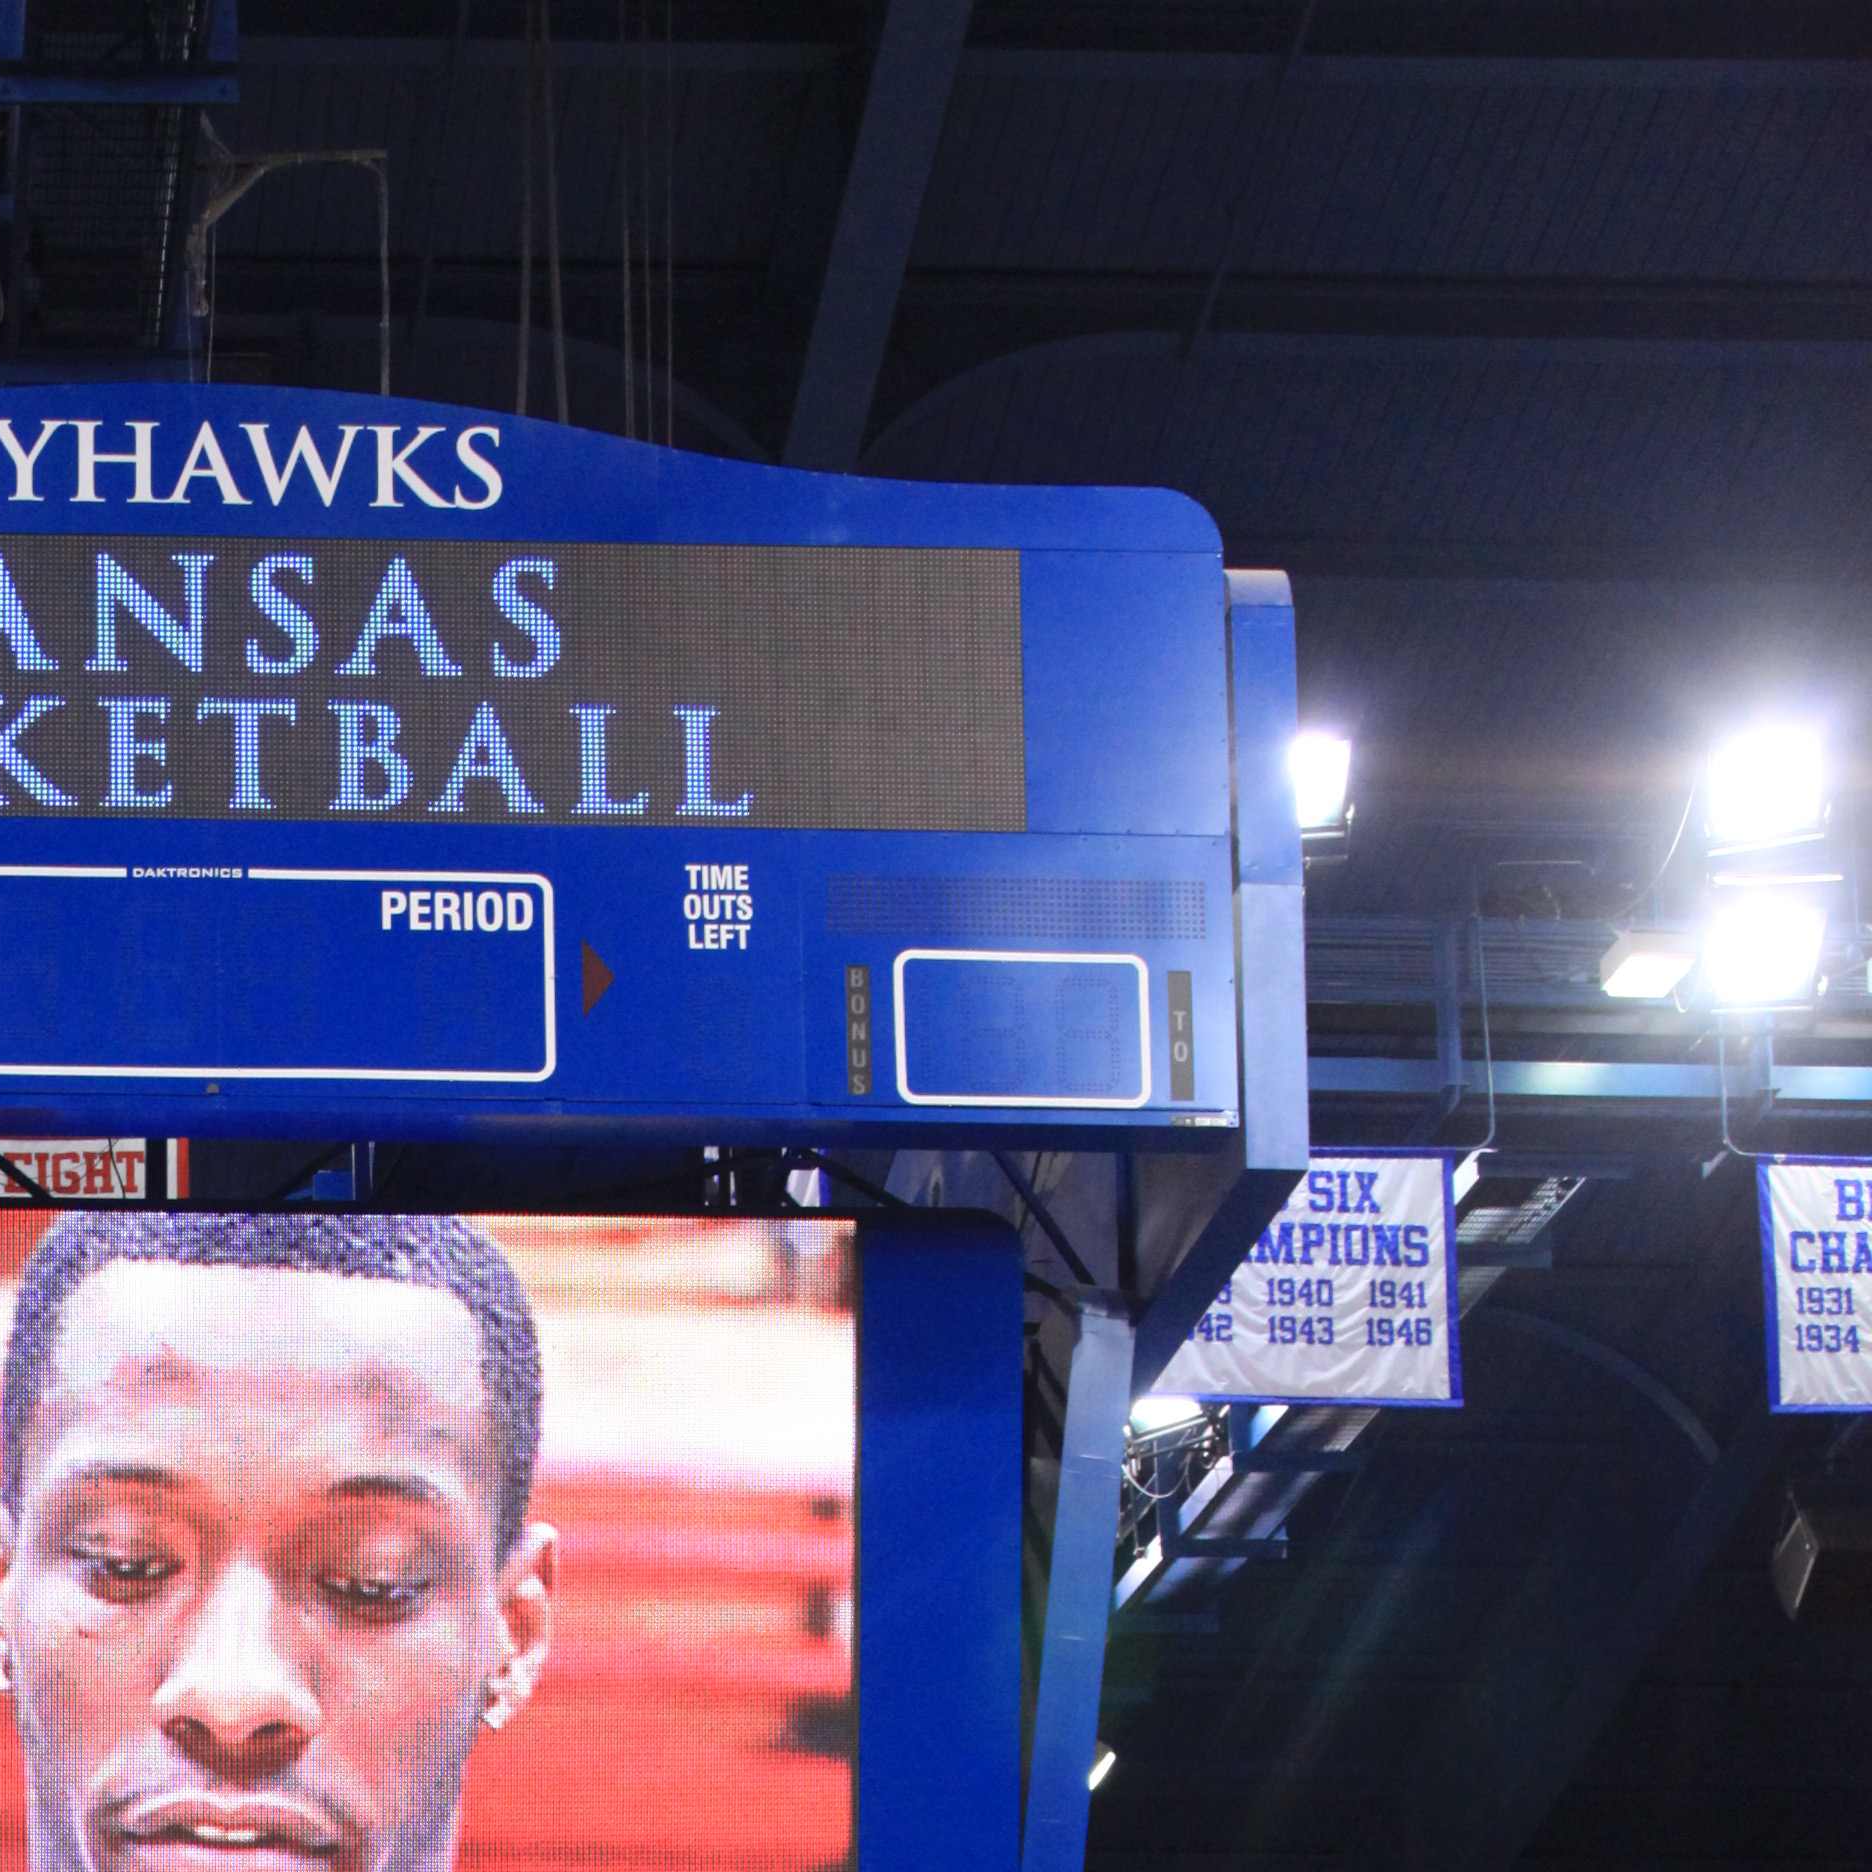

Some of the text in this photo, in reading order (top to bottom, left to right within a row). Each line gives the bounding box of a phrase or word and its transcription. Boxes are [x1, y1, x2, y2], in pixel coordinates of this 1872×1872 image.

[131, 868, 243, 879] DAKTRONICS
[684, 864, 749, 891] TIME
[381, 891, 534, 933] PERIOD
[683, 893, 753, 922] OUTS
[687, 924, 750, 951] LEFT
[849, 967, 868, 1096] BONUS
[1171, 1010, 1188, 1063] TO
[2, 1151, 145, 1194] EIGHT
[1308, 1171, 1380, 1214] SIX
[1244, 1222, 1430, 1267] MPIONS
[1266, 1278, 1334, 1307] 1940
[1368, 1280, 1427, 1309] 1941
[1795, 1287, 1855, 1315] 1931
[1267, 1316, 1334, 1346] 1943
[1366, 1317, 1433, 1347] 1946
[1794, 1324, 1860, 1353] 1934
